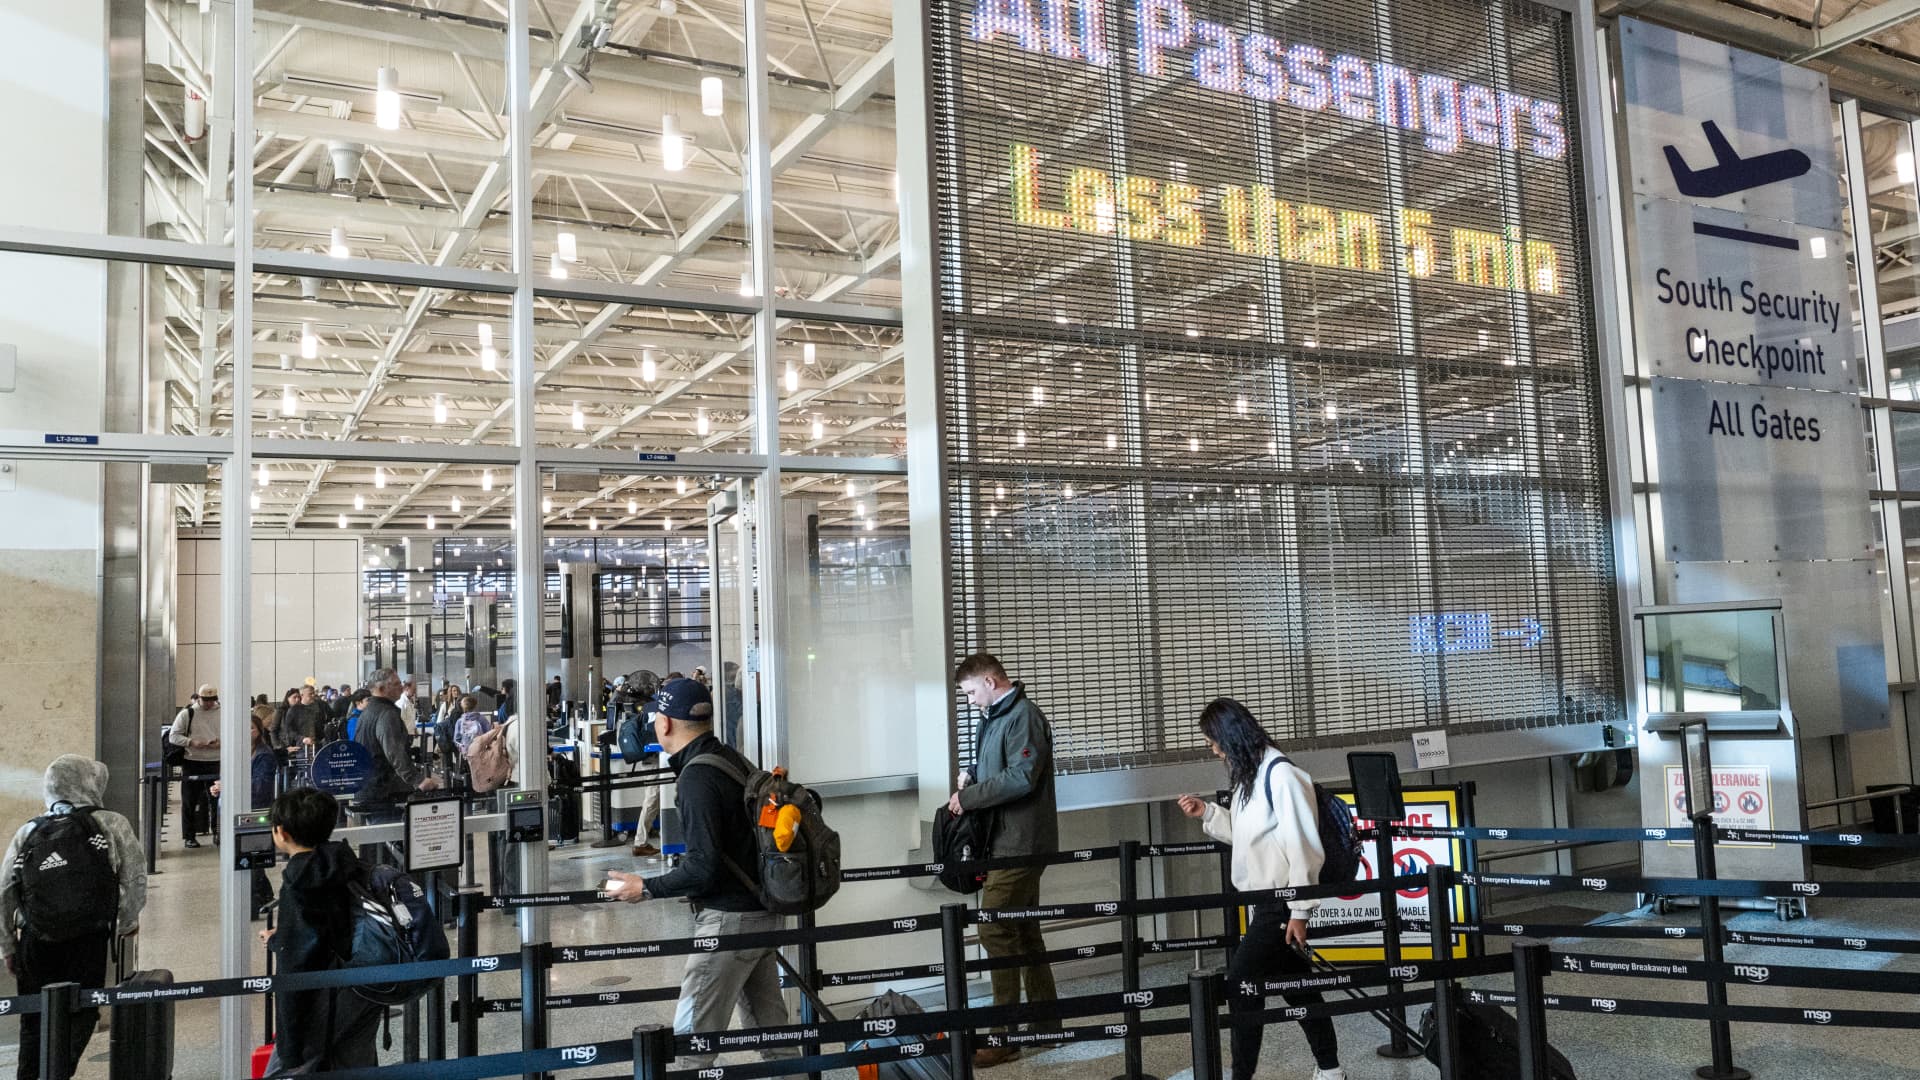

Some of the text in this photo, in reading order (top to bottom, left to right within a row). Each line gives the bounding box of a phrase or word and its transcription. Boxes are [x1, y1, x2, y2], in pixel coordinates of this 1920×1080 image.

[973, 0, 1566, 159] All Passengers
[1010, 143, 1206, 247] Less
[1221, 184, 1383, 272] than
[1452, 225, 1560, 296] min
[1656, 268, 1840, 334] South Security
[1686, 327, 1826, 379] Checkpoint
[1708, 400, 1821, 442] All Gates
[1711, 774, 1760, 786] LERANCE
[1489, 829, 1508, 838] msp
[1646, 829, 1667, 839] msp
[1839, 834, 1862, 844] msp
[1074, 850, 1092, 860] msp
[926, 864, 944, 874] msp
[1482, 876, 1508, 885] Emergency
[1510, 878, 1538, 886] Breakaway
[1583, 878, 1607, 889] msp
[1792, 882, 1820, 894] msp
[1275, 888, 1296, 898] msp
[1096, 902, 1118, 914] msp
[1320, 908, 1339, 918] OVER
[1354, 908, 1363, 916] OZ
[1365, 908, 1380, 916] AND
[894, 918, 917, 930] msp
[1504, 925, 1524, 934] msp
[1665, 928, 1686, 937] msp
[585, 938, 718, 957] Emergency Breakaway Belt msp
[1750, 935, 1776, 943] Emergency
[1844, 938, 1866, 948] msp
[1078, 946, 1096, 956] msp
[472, 957, 499, 968] msp
[1590, 960, 1769, 981] Emergency Breakaway Belt msp
[1265, 965, 1419, 990] Emergency Breakaway Belt msp
[117, 978, 272, 1000] Emergency Breakaway Belt msp
[599, 992, 620, 1002] msp
[1123, 991, 1154, 1006] msp
[1592, 998, 1616, 1010] msp
[1286, 1006, 1307, 1018] msp
[1804, 1010, 1832, 1023] msp
[720, 1018, 896, 1045] Emergency Breakaway Belt msp
[1105, 1024, 1128, 1036] msp
[562, 1045, 597, 1062] msp
[900, 1042, 924, 1055] msp
[699, 1068, 724, 1080] msp
